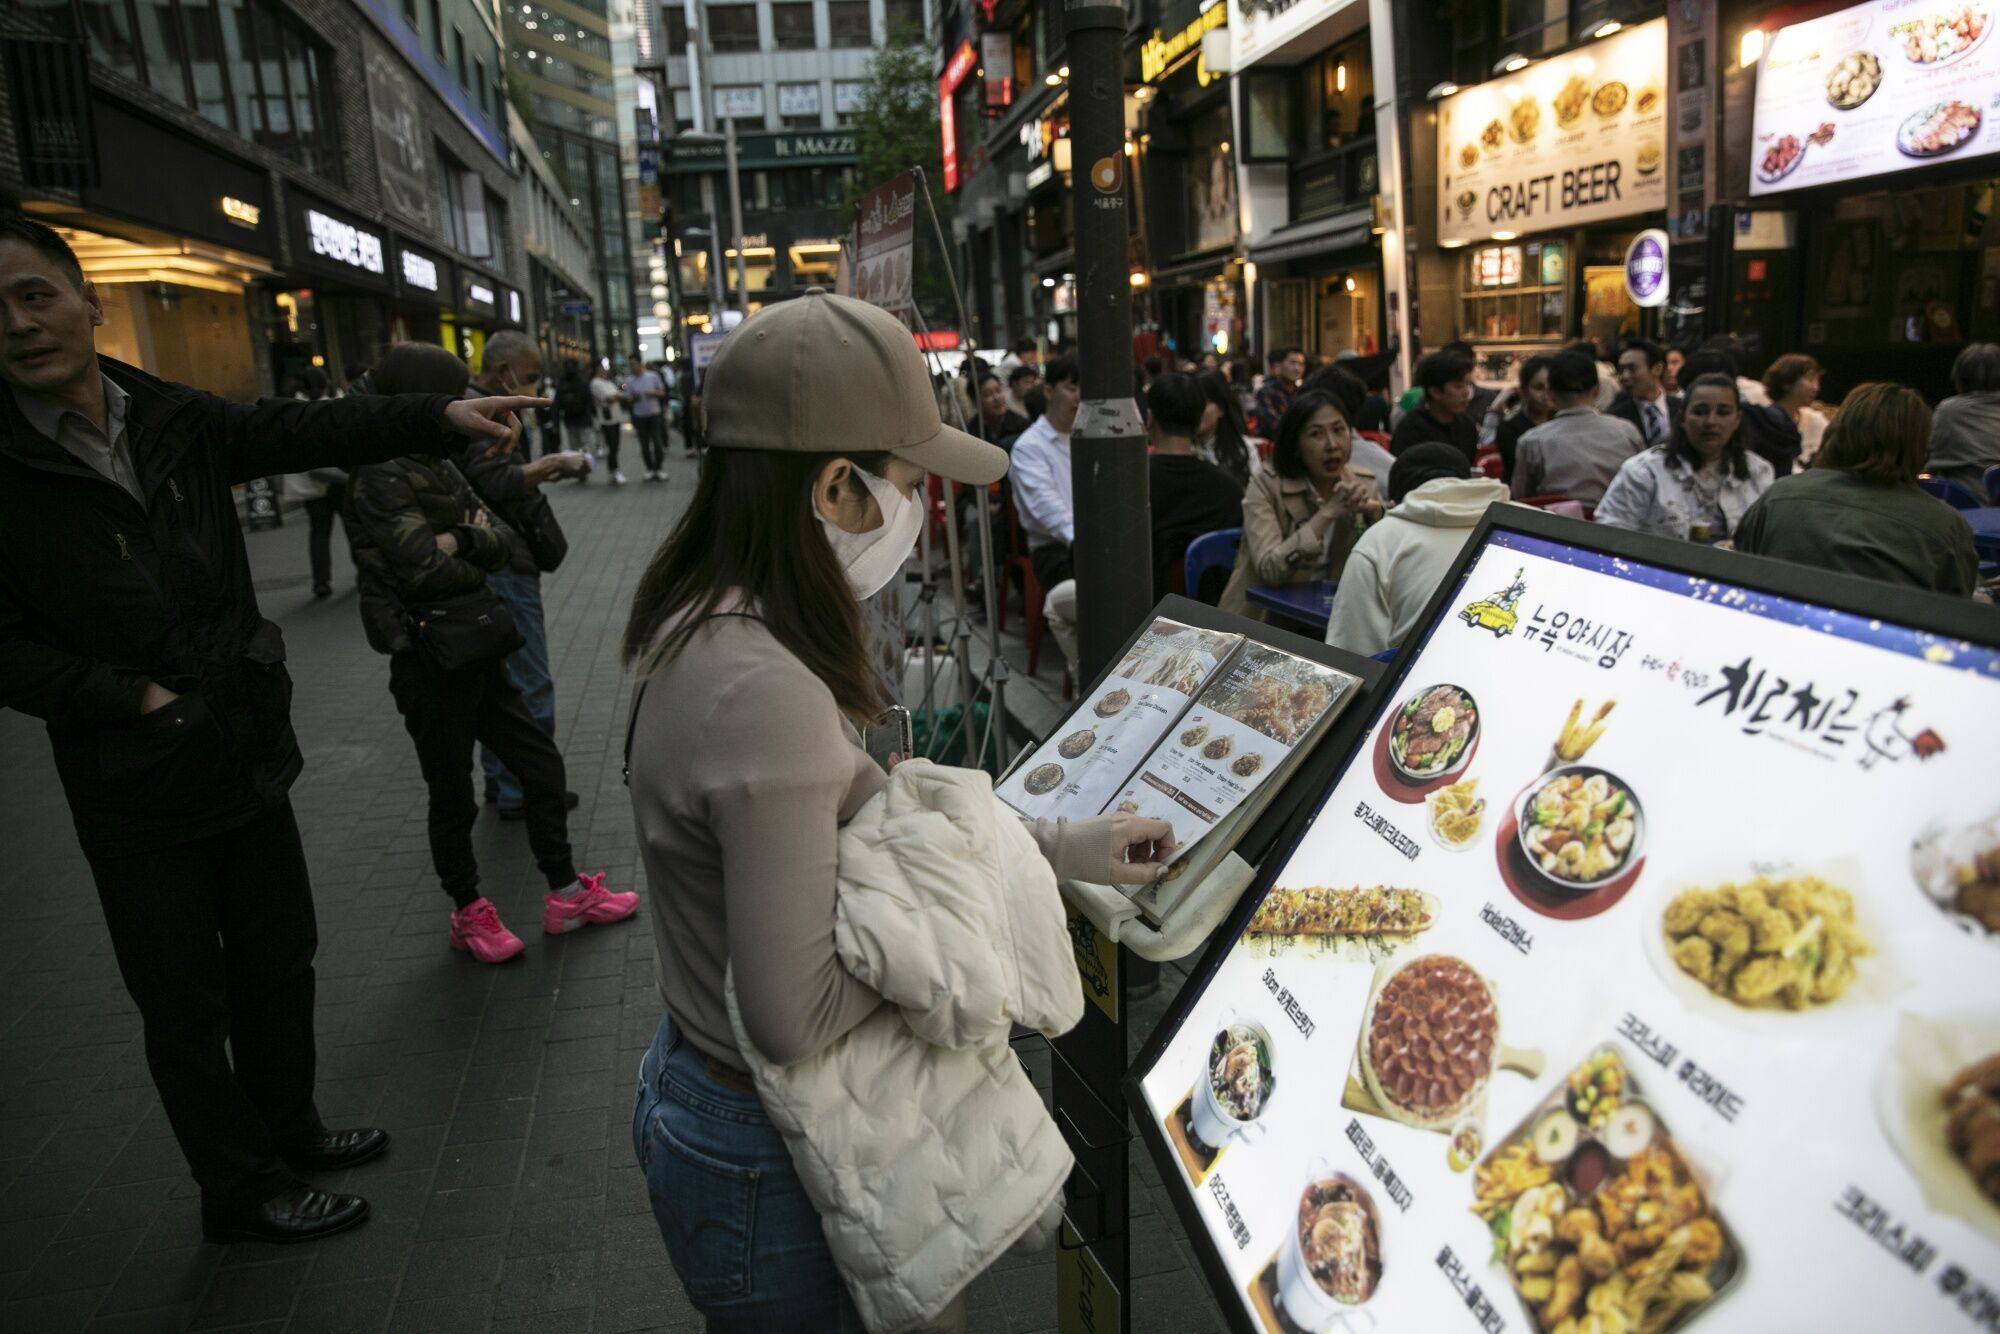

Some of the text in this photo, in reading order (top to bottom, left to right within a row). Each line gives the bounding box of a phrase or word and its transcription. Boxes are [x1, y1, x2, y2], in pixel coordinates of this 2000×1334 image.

[775, 137, 789, 156] IL
[1092, 197, 1123, 209] 서울중구
[1486, 160, 1621, 223] CRAFT BEER
[1523, 604, 1634, 669] 뉴욕야시장
[1262, 967, 1280, 995] 50cm
[1615, 1011, 1679, 1069] 크리스피
